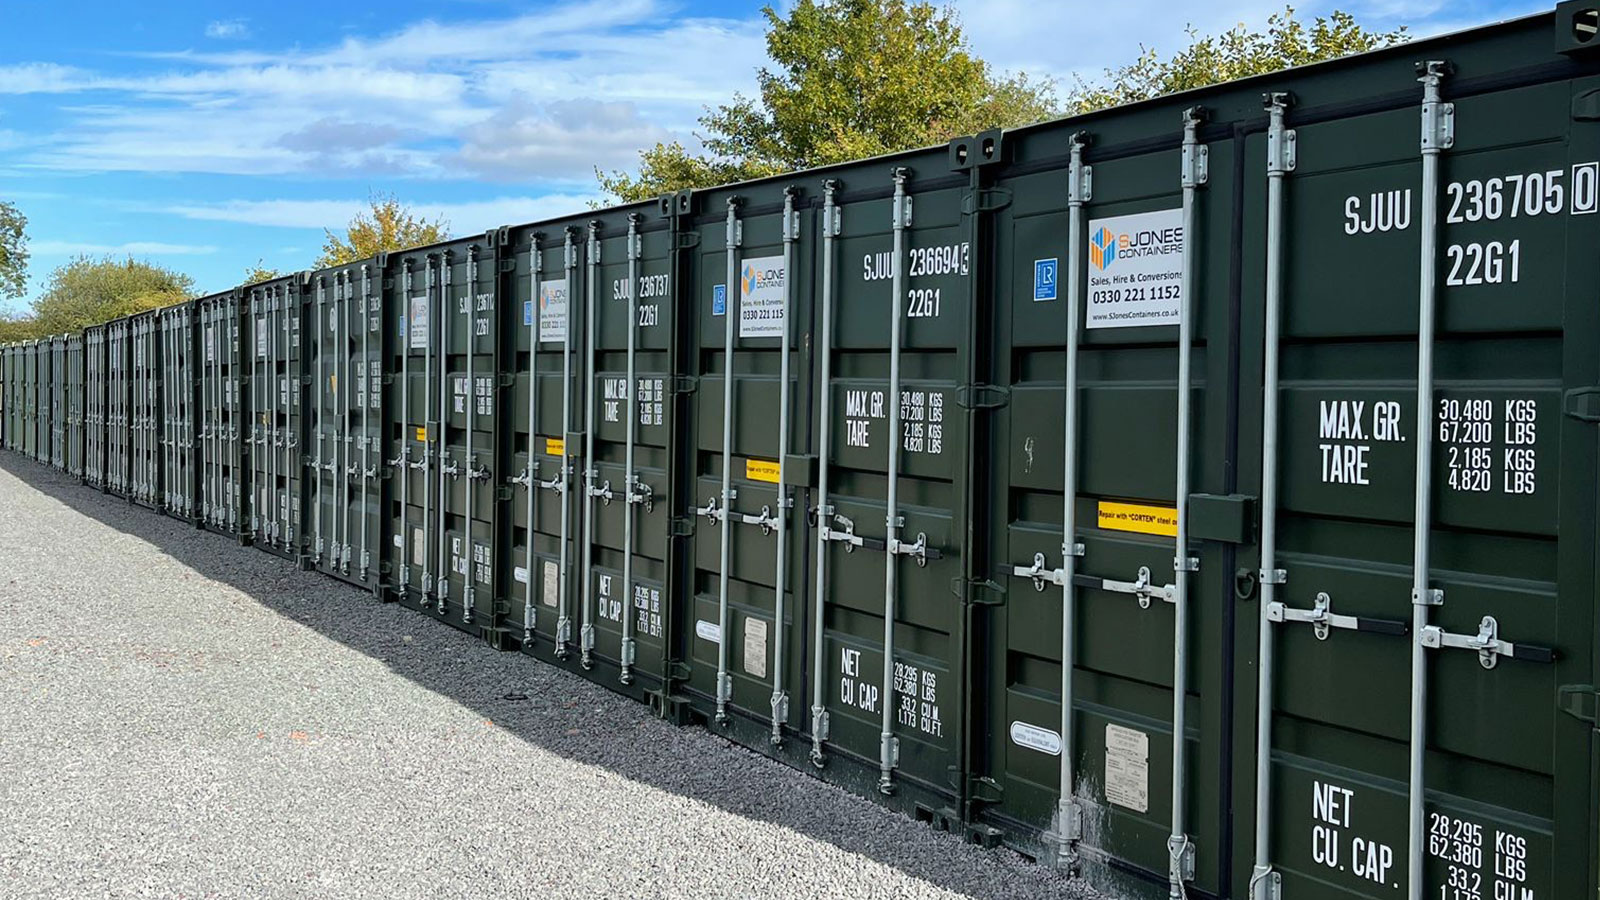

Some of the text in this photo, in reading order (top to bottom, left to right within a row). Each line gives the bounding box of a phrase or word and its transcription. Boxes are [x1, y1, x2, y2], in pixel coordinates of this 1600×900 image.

[1344, 166, 1595, 235] SJUU 236705 0
[756, 268, 784, 281] SJONE
[863, 252, 894, 281] SJUU
[1446, 239, 1520, 286] 22G1
[1091, 277, 1111, 287] Sales,
[1113, 275, 1128, 284] Hire
[1130, 274, 1135, 283] &
[907, 288, 941, 318] 22G1
[1093, 285, 1180, 304] 0330 221 1152
[639, 304, 658, 326] 22G1
[743, 308, 784, 320] 0330 221 115
[604, 401, 619, 422] TARE
[846, 391, 886, 418] MAX. GR.
[929, 392, 943, 407] KGS
[1439, 399, 1536, 422] 30,480 KGS
[928, 407, 942, 422] LBS
[1319, 400, 1406, 442] MAX. GR.
[846, 420, 870, 448] TARE
[928, 423, 942, 439] KGS
[1439, 421, 1536, 445] 67,200 LBS
[927, 438, 942, 454] LBS
[1319, 444, 1370, 485] TARE
[1448, 446, 1536, 471] 2,185 KGS
[1448, 468, 1535, 494] 4,820 LBS
[1099, 510, 1115, 519] Repair
[1157, 517, 1171, 525] steel
[599, 574, 612, 597] NET
[841, 647, 861, 677] NET
[922, 670, 936, 688] KGS
[841, 677, 880, 714] CU. CAP.
[901, 695, 917, 714] 33.2
[921, 685, 936, 703] LBS
[1313, 781, 1353, 828] NET
[1495, 830, 1526, 859] KGS
[1312, 825, 1399, 889] CU. CAP.
[1495, 853, 1526, 882] LBS
[1448, 865, 1481, 895] 33.2
